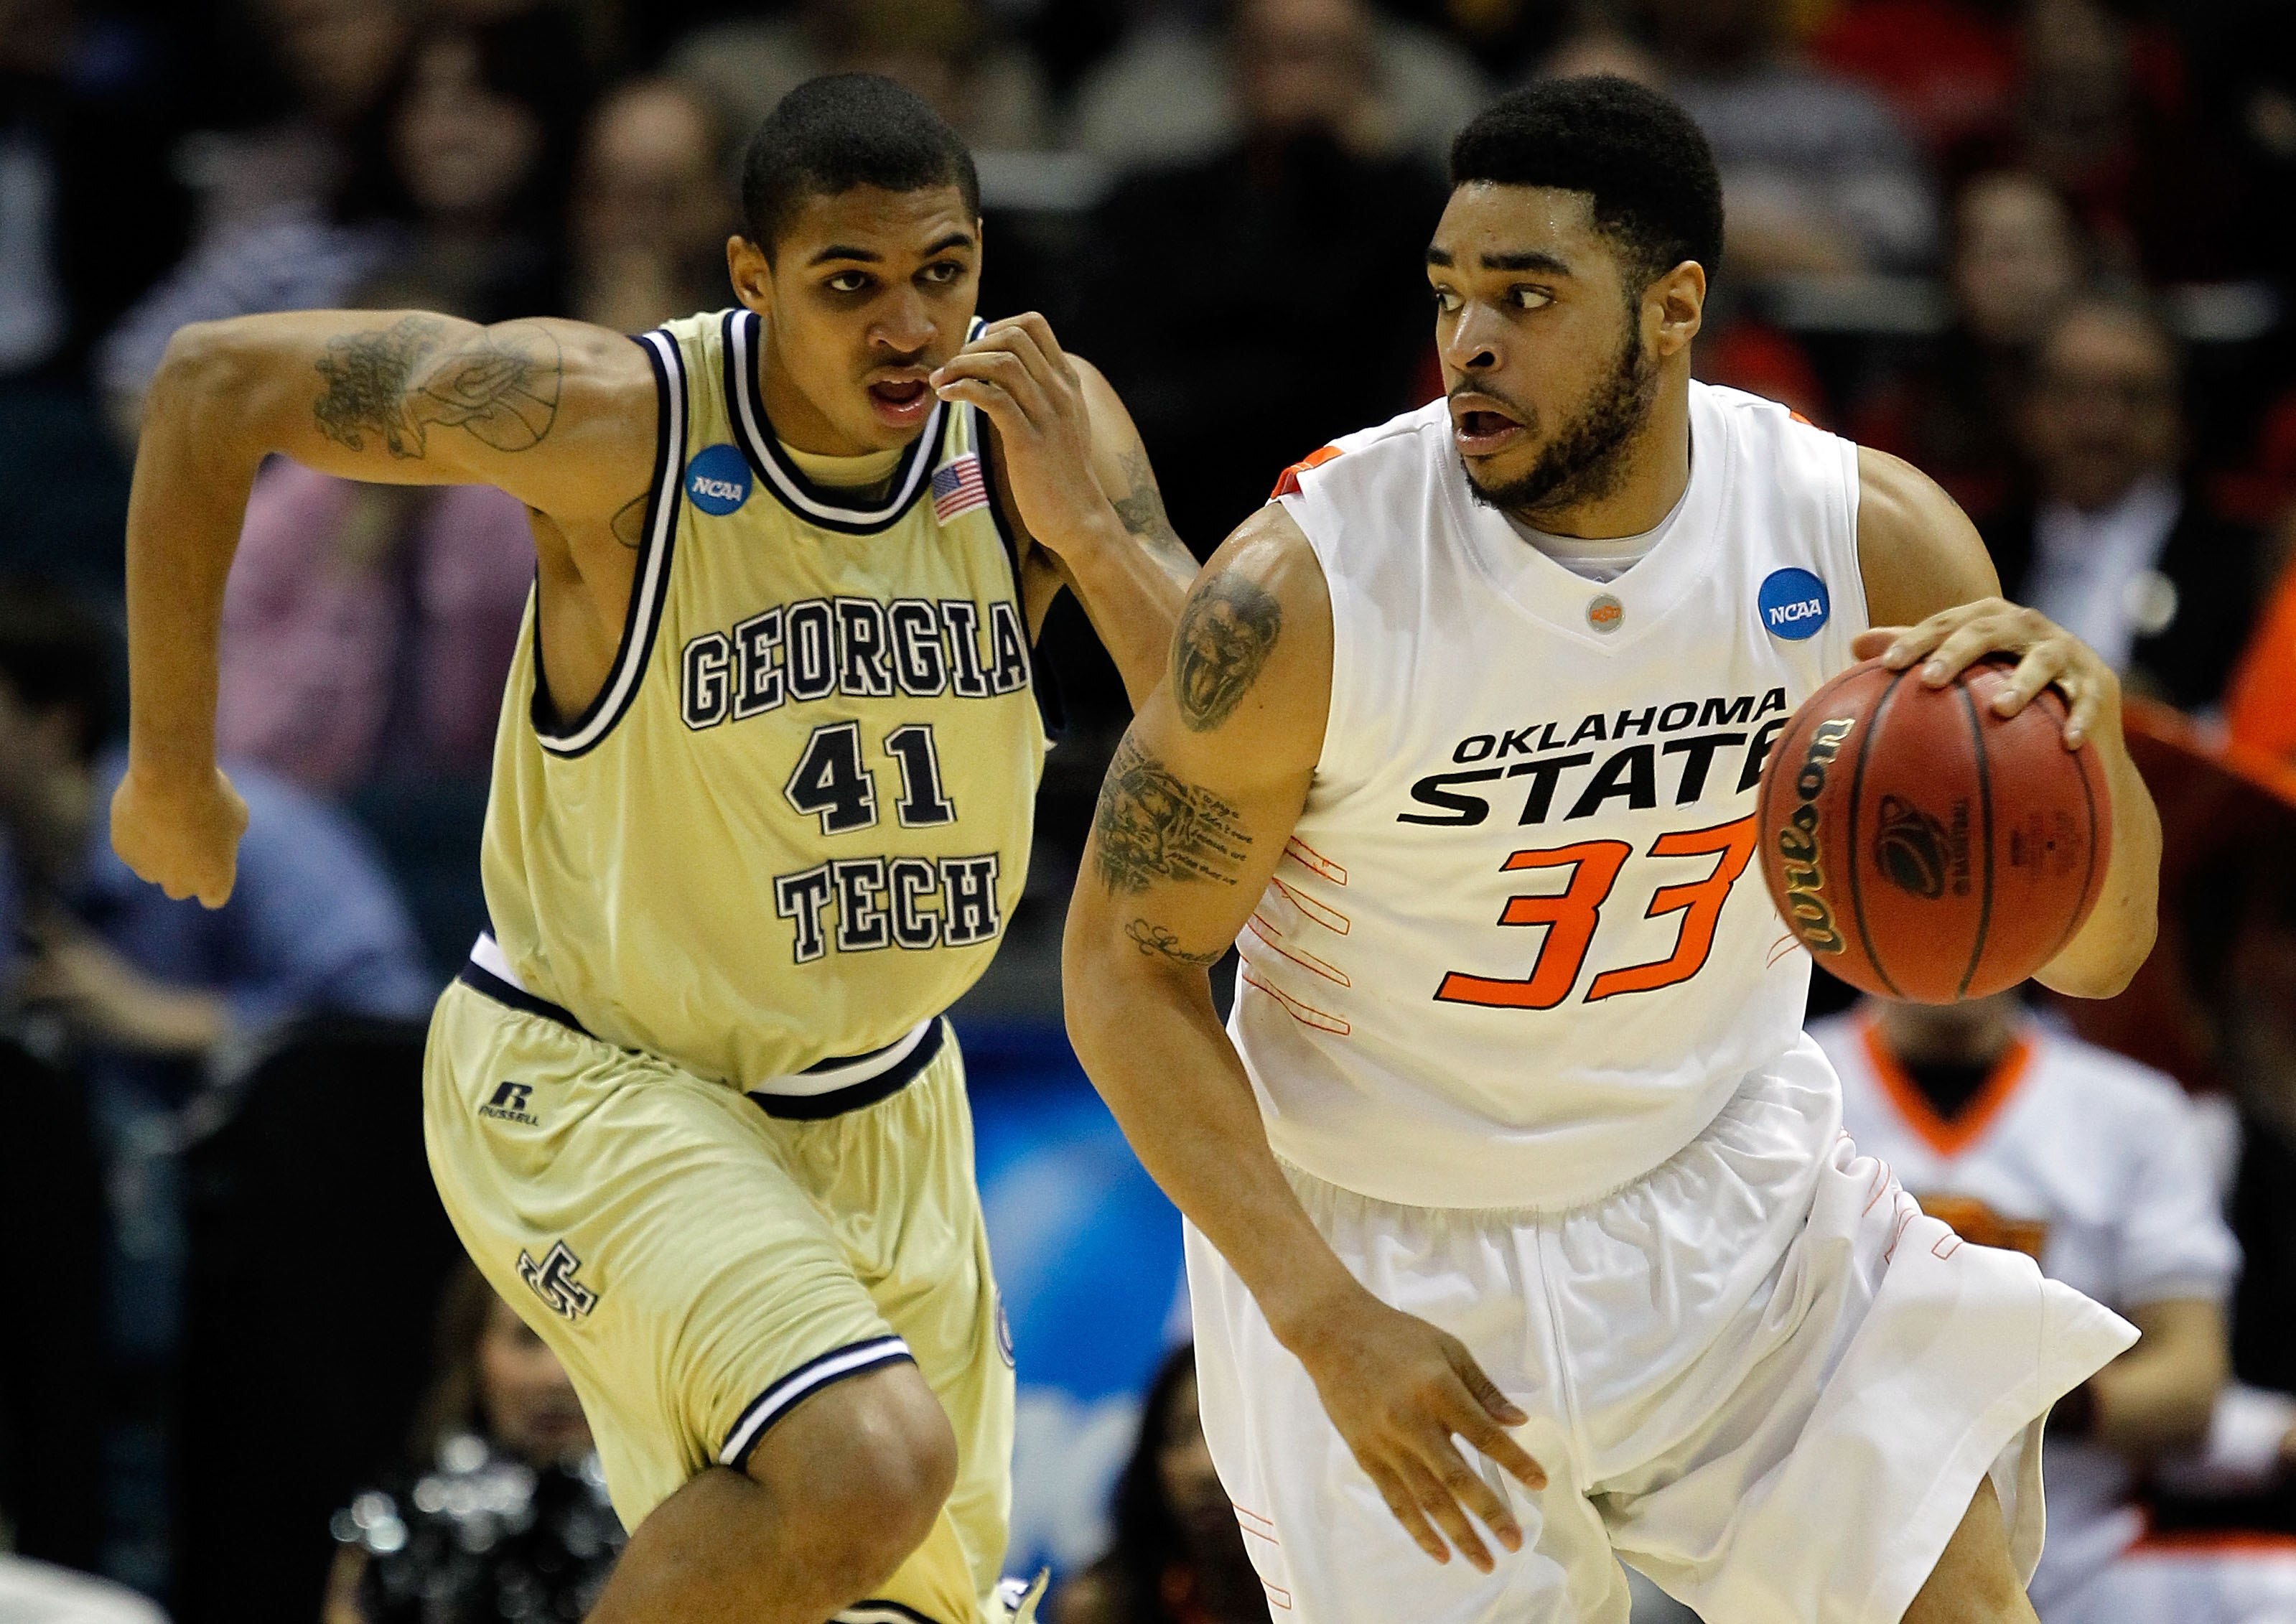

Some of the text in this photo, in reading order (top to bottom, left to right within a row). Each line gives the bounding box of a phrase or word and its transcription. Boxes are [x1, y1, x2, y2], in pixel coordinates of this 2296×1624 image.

[691, 475, 743, 502] NCAA
[681, 596, 1032, 731] GEORGIA
[1768, 599, 1823, 625] NCAA
[783, 719, 957, 836] 41
[1452, 687, 1786, 765] OKLAHOMA
[773, 852, 1001, 965] TECH
[1432, 814, 1758, 1011] 33
